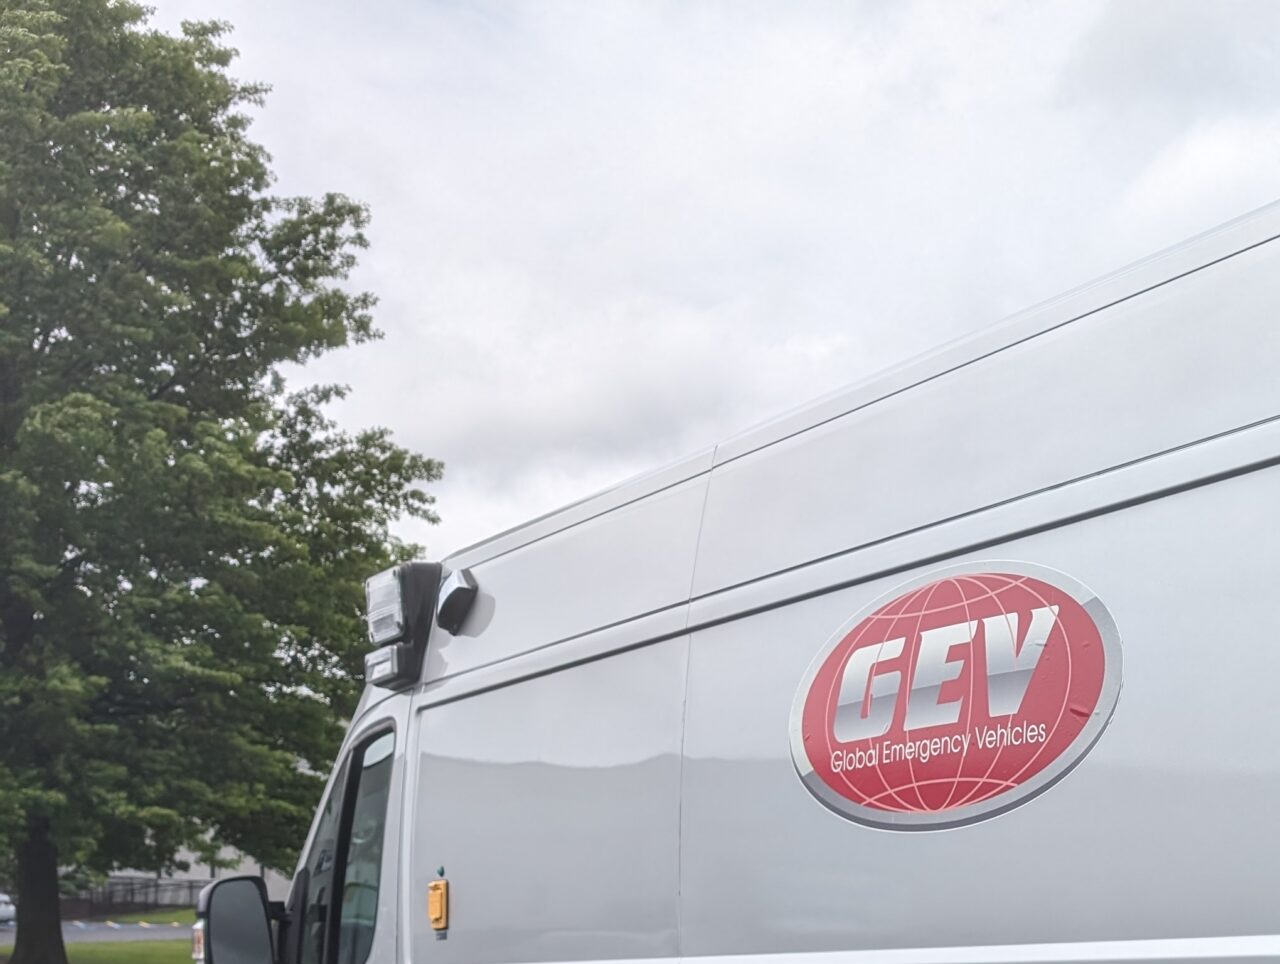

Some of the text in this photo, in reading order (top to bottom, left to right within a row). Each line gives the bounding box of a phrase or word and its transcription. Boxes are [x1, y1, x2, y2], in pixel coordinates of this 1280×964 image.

[833, 605, 1060, 743] GEV
[831, 720, 1046, 773] Global Emergency Vehicles
